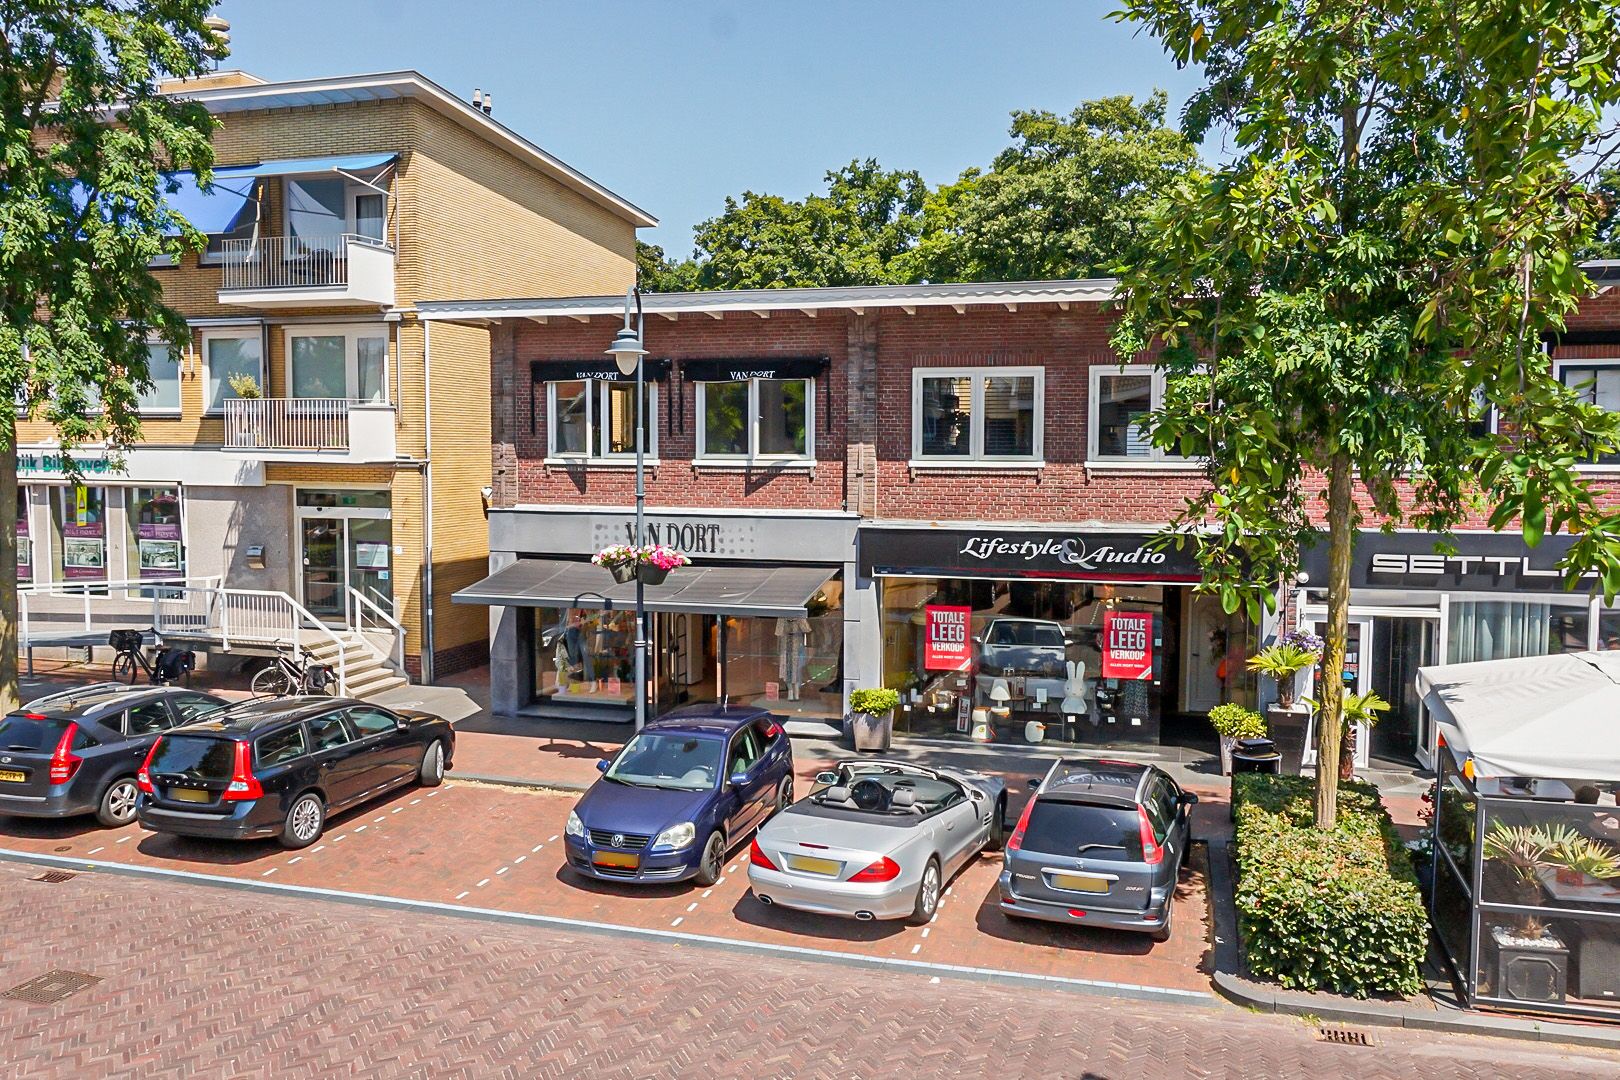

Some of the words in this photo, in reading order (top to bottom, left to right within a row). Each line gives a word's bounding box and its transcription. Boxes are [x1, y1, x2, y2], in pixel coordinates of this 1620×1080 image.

[594, 372, 618, 380] DORT
[730, 371, 748, 379] VAN
[625, 522, 660, 547] VN
[666, 523, 720, 553] DORT
[960, 537, 1062, 561] Lifestyle
[1085, 546, 1166, 565] Audio
[931, 611, 965, 623] TOTALE
[1110, 617, 1146, 630] TOTALE
[931, 623, 965, 641] LEEG
[1110, 630, 1146, 649] LEEG
[931, 641, 965, 652] VERKOOP
[1110, 649, 1146, 660] VERKOOP
